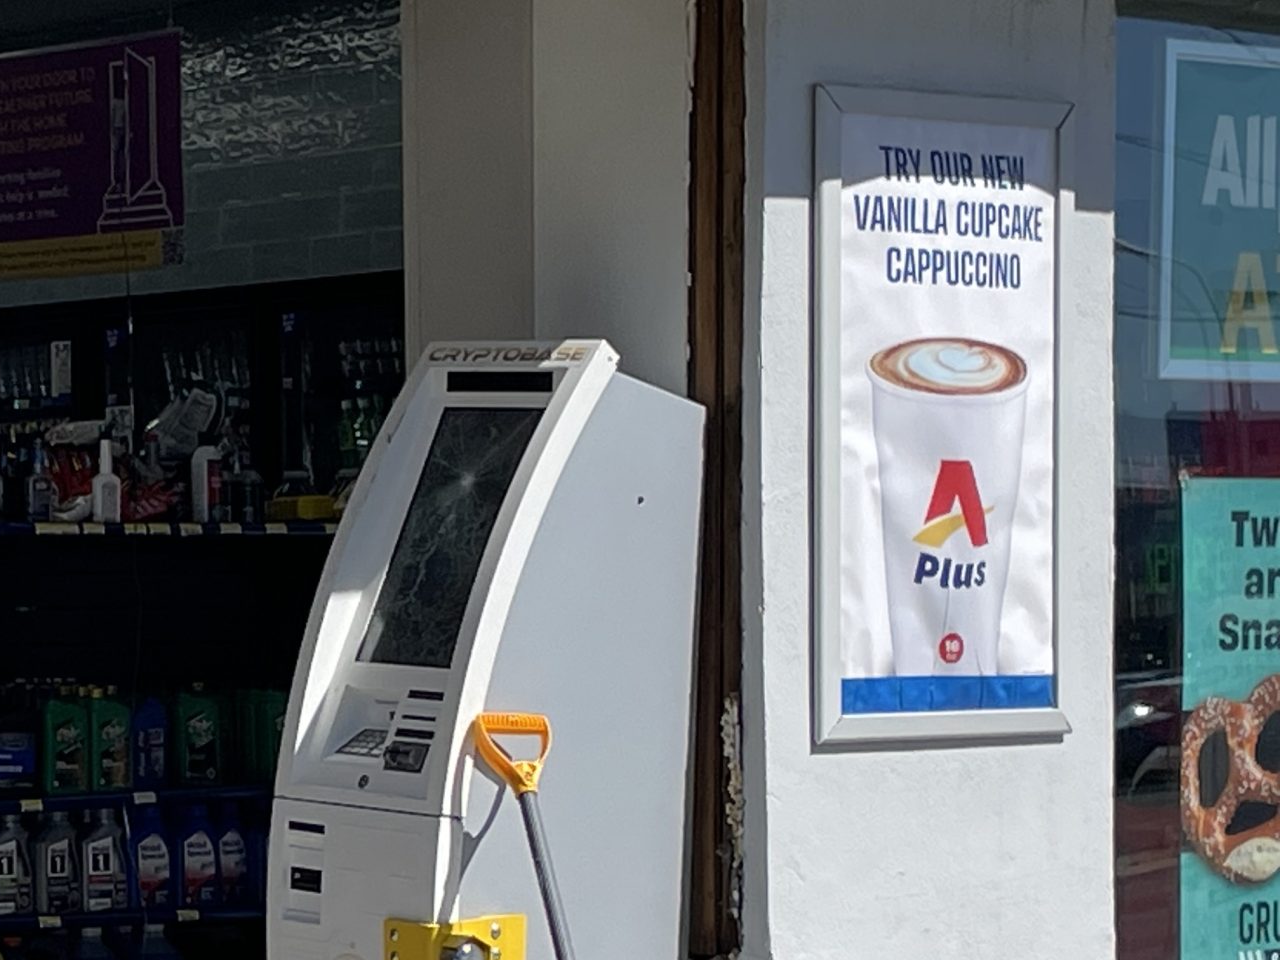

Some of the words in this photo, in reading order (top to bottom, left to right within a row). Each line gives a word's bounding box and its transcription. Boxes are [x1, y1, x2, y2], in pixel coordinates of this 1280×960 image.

[879, 146, 920, 183] TRY
[930, 150, 976, 187] OUR
[981, 154, 1025, 191] NEW
[854, 194, 948, 235] VANILLA
[956, 200, 1043, 242] CUPCAKE
[886, 247, 1021, 289] CAPPUCCINO
[1220, 253, 1280, 354] A
[428, 346, 587, 363] CRYPTOBASE
[913, 552, 986, 589] Plus
